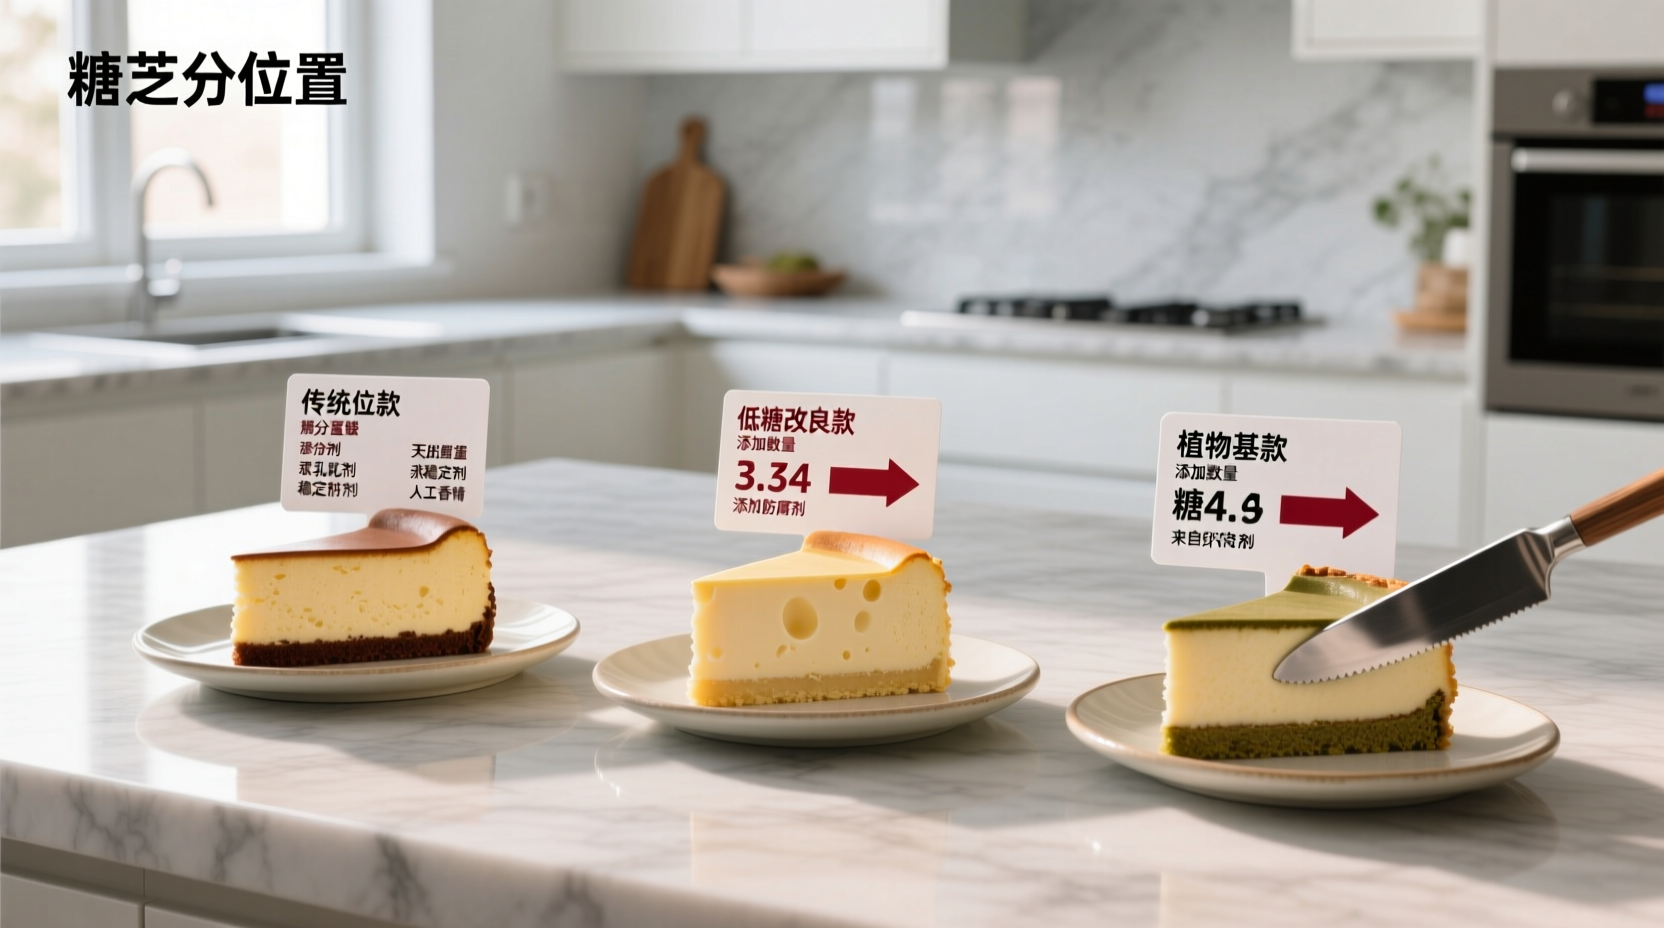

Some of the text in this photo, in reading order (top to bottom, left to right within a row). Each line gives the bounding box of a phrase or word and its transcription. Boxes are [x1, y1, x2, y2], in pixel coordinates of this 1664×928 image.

[301, 388, 400, 417] 传统位款
[737, 405, 856, 436] 低糖改良款
[1176, 429, 1288, 463] 植物基款
[734, 460, 812, 494] 3.34
